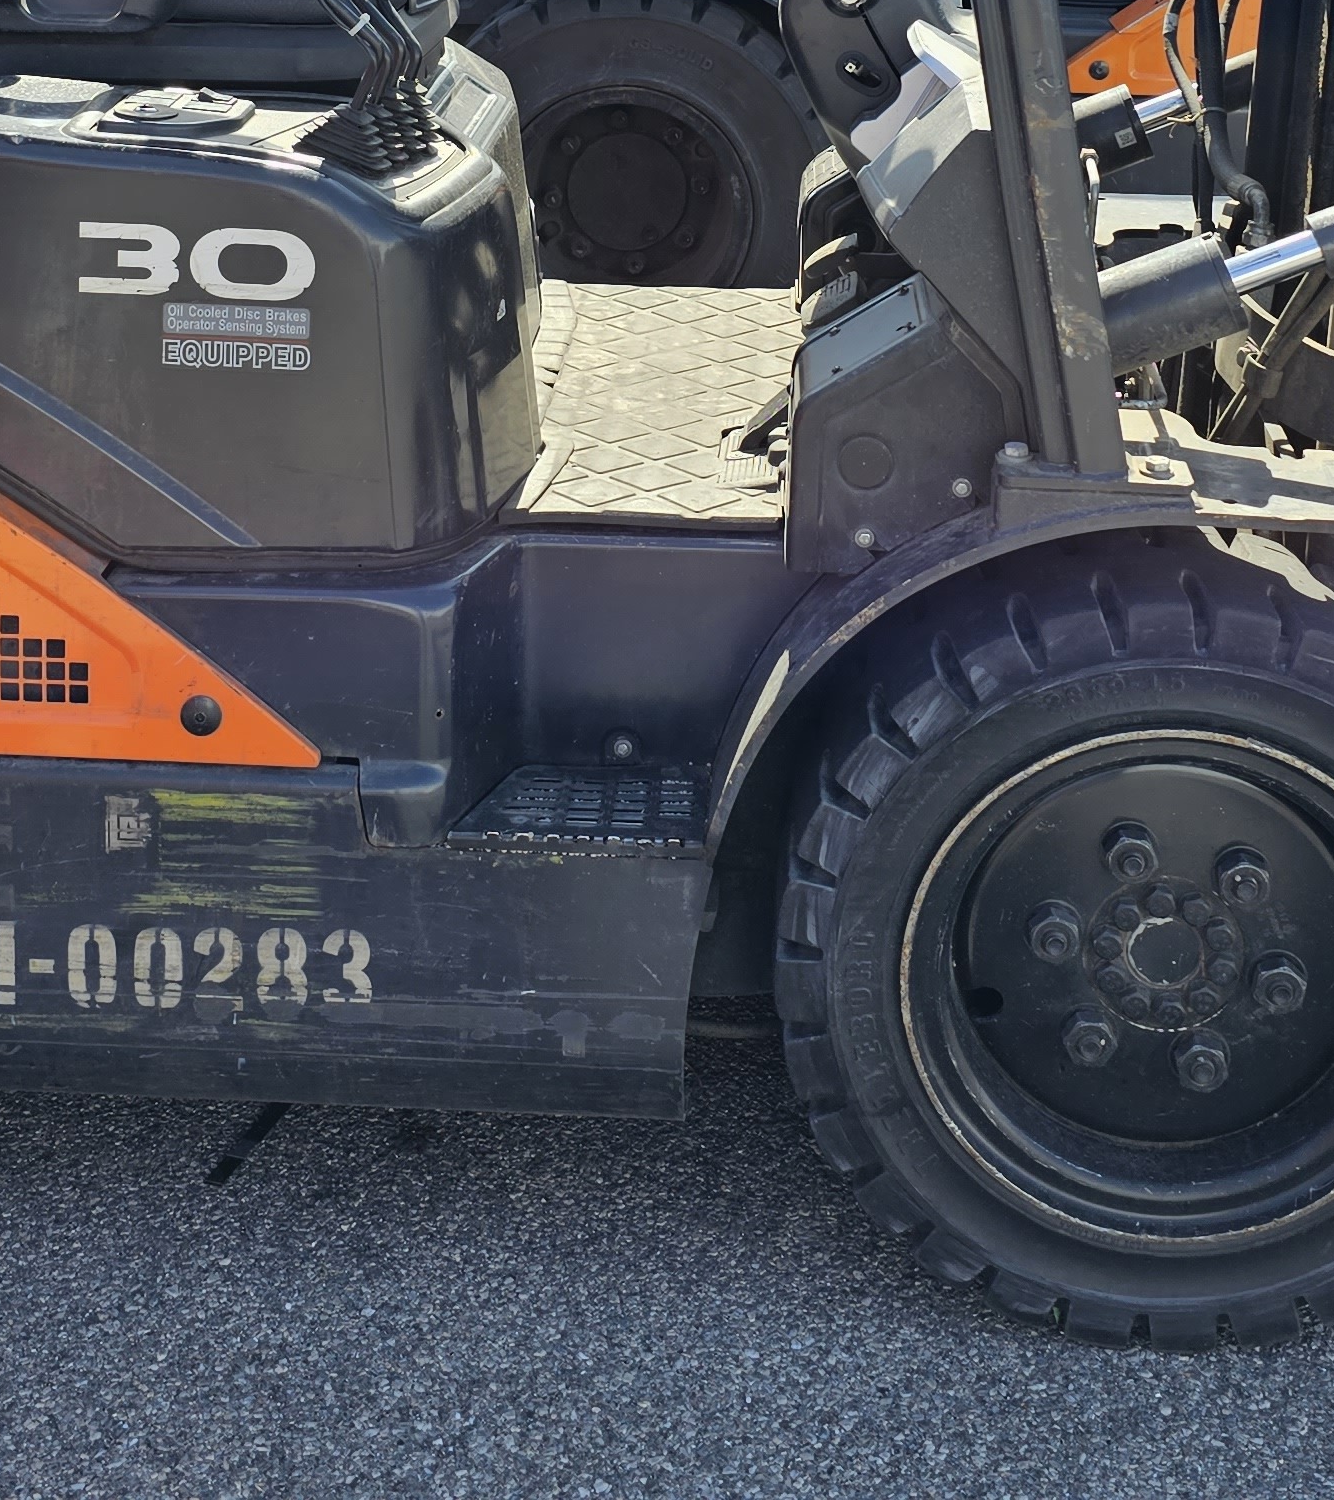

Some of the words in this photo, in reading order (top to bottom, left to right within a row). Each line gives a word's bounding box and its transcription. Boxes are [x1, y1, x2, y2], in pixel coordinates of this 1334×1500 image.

[78, 221, 317, 302] 30
[167, 304, 184, 317] Oil
[188, 305, 229, 319] Cooled
[234, 307, 261, 320] Disc
[265, 308, 307, 323] Brakes
[167, 316, 216, 332] Operator
[218, 319, 263, 336] Sensing
[265, 321, 307, 337] System
[161, 338, 311, 371] EQUIPPED
